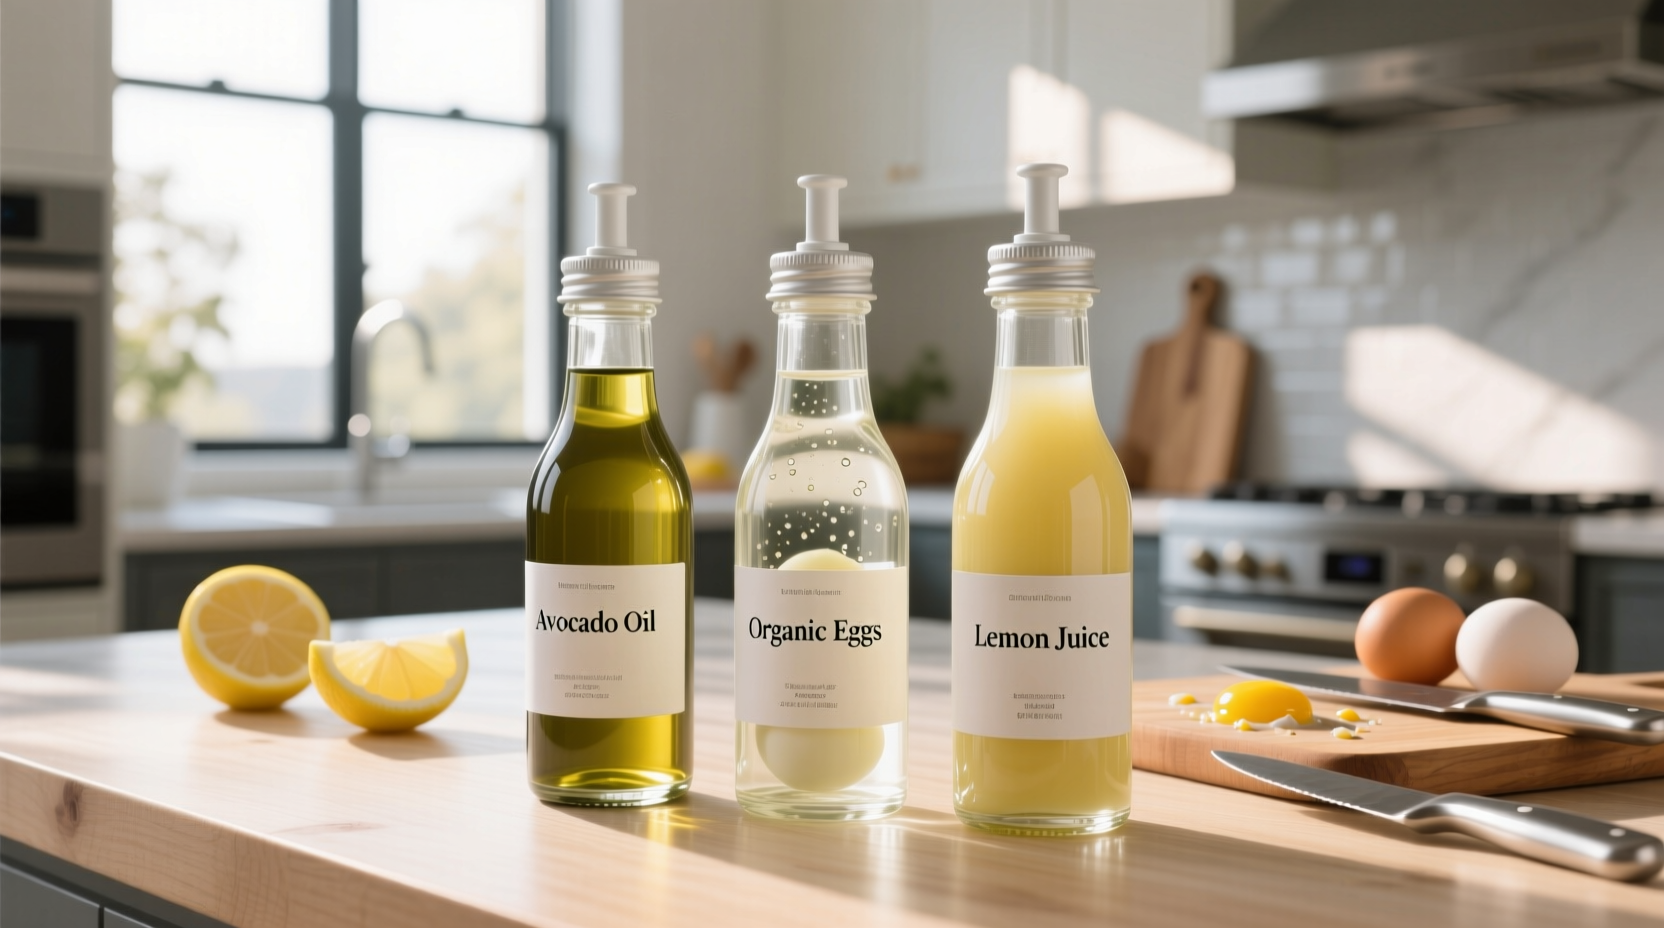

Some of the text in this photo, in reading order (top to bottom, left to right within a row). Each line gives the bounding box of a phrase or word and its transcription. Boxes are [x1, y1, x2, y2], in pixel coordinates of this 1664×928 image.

[535, 609, 656, 633] Avocado Oil
[749, 616, 882, 648] Organic Eggs
[975, 624, 1110, 651] Lemon Juice
